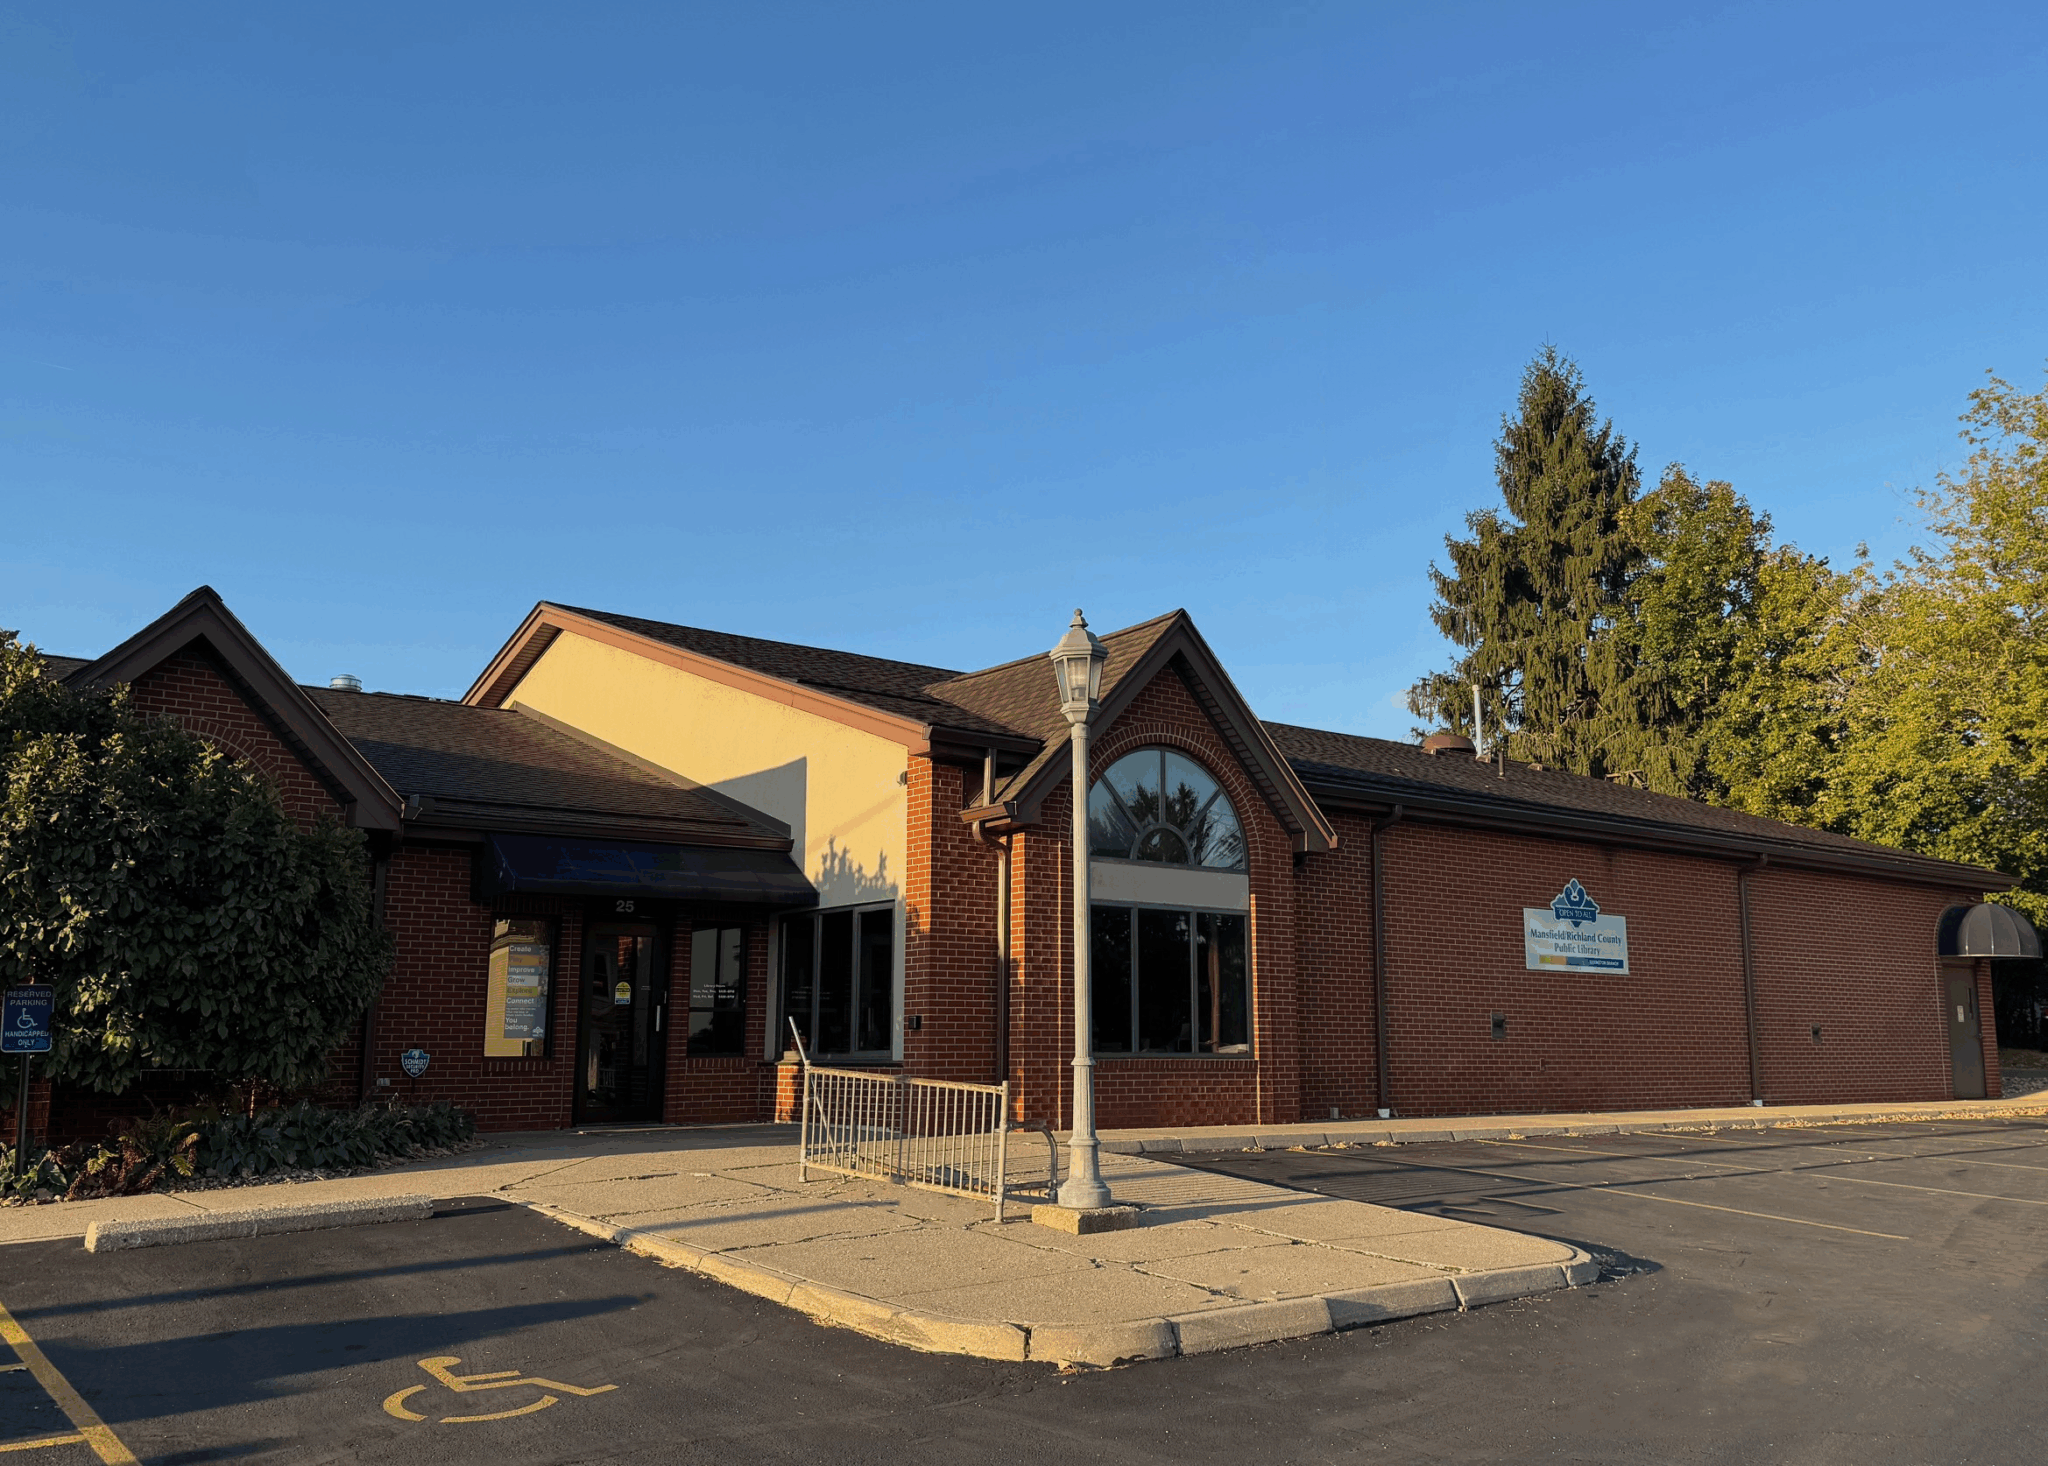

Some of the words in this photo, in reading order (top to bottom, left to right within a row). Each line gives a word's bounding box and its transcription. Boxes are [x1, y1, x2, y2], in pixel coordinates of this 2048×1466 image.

[616, 900, 634, 913] 25
[1559, 909, 1574, 917] OPEN
[1575, 910, 1583, 918] TO
[1583, 911, 1593, 919] ALL
[1530, 928, 1596, 943] Mansfield/Richland
[1597, 933, 1622, 947] County
[1554, 942, 1576, 953] Public
[1577, 944, 1601, 956] Library
[508, 966, 536, 974] Improve
[7, 990, 52, 998] RESERVED
[505, 1024, 530, 1032] belong.
[17, 1038, 36, 1046] ONLY
